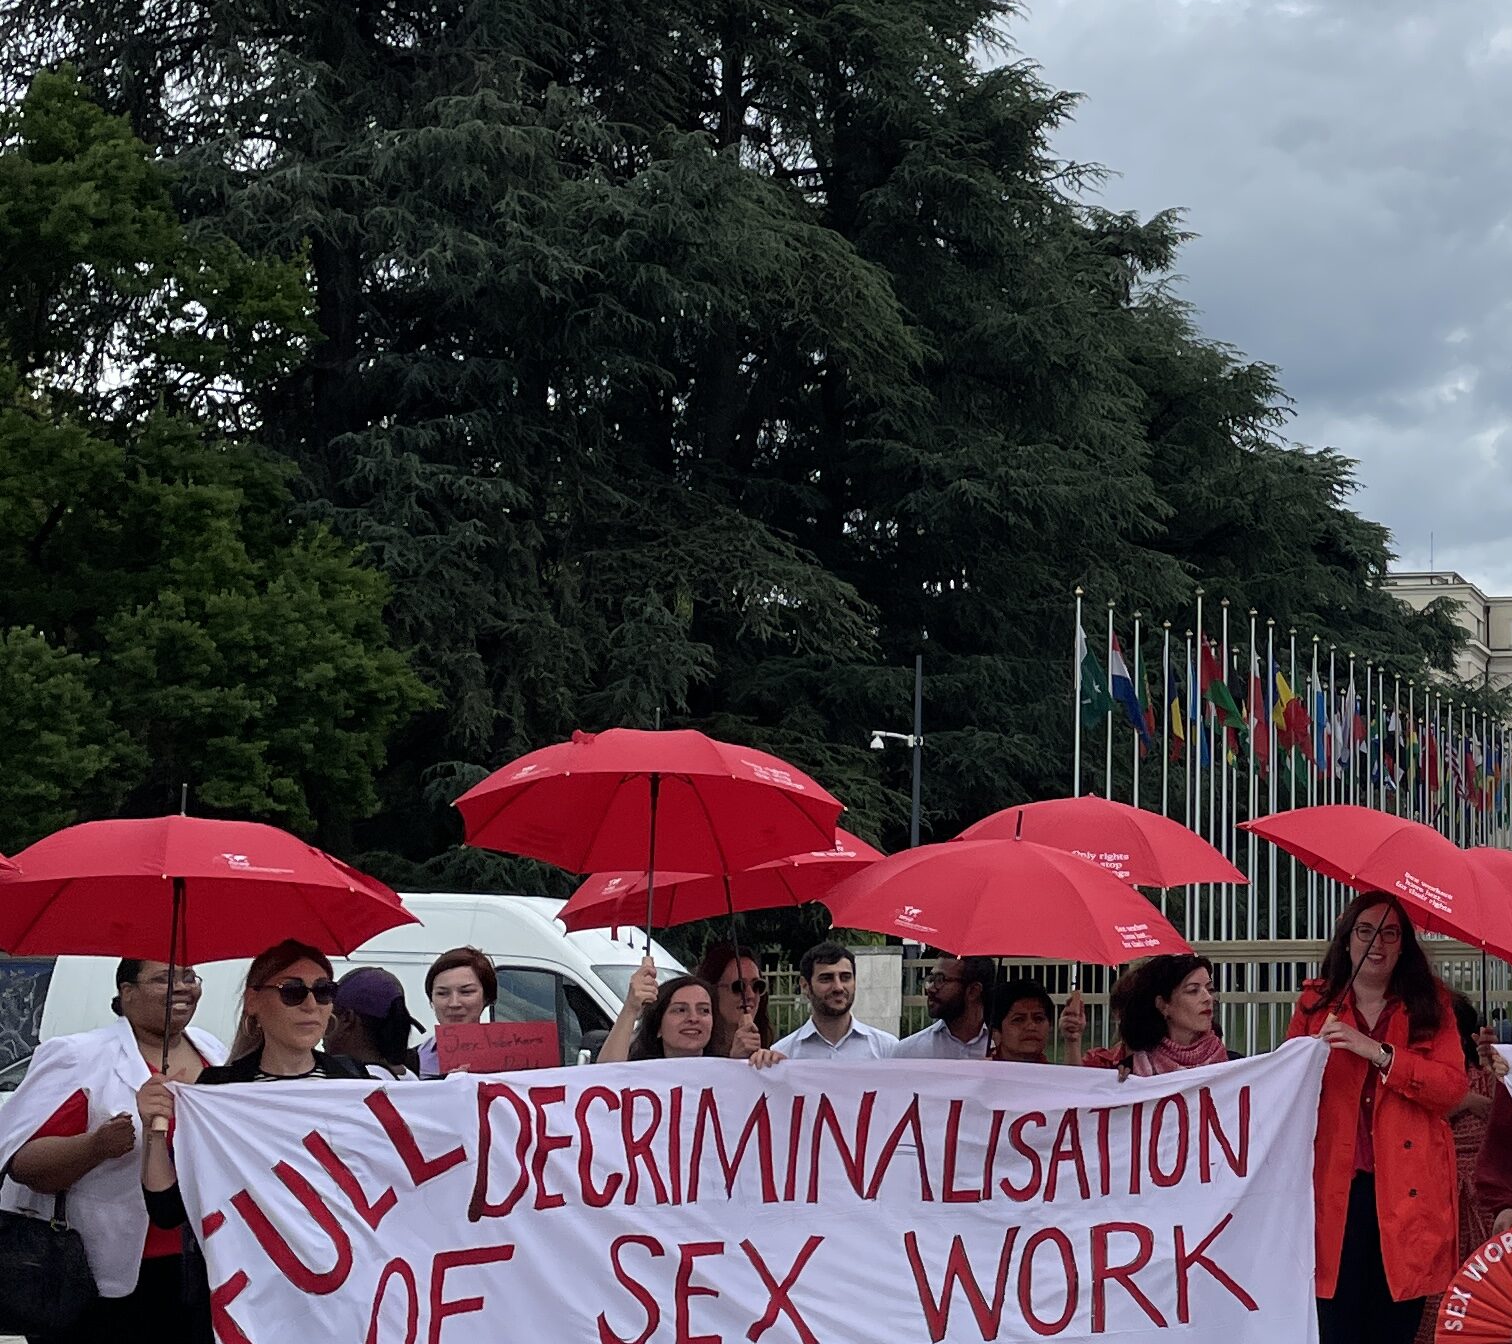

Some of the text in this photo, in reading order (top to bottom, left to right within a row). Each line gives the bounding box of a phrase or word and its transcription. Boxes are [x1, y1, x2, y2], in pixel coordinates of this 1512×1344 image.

[1099, 853, 1130, 862] rights
[443, 1027, 480, 1053] Sex
[467, 1083, 1251, 1222] DECRIMINALISATION
[903, 1212, 1260, 1344] WORK
[1444, 1286, 1472, 1331] SEX
